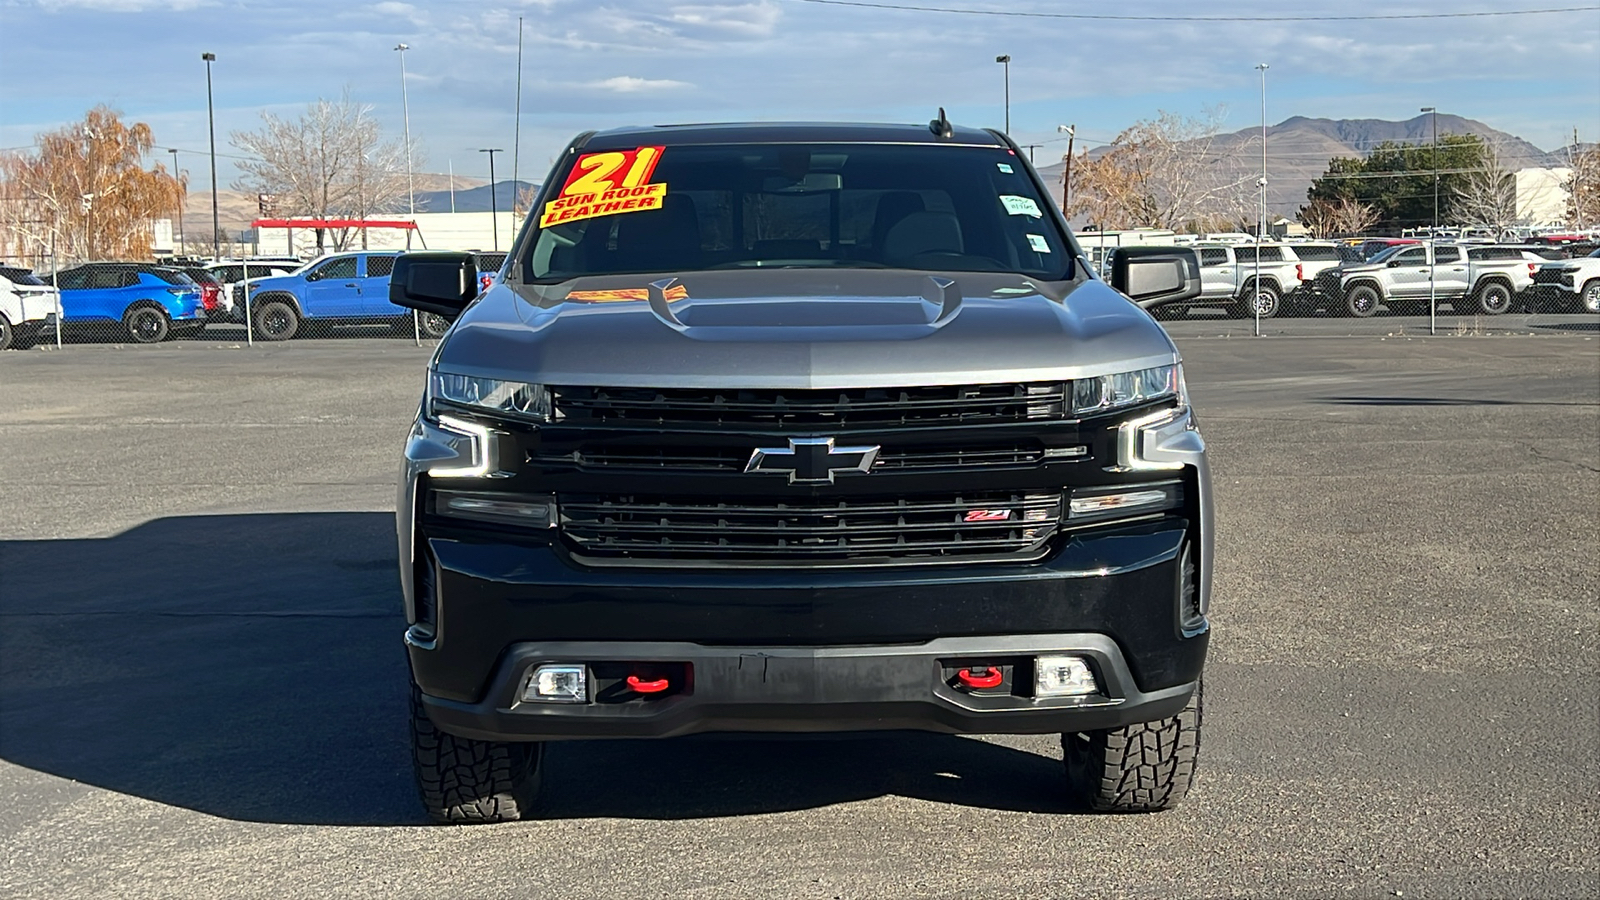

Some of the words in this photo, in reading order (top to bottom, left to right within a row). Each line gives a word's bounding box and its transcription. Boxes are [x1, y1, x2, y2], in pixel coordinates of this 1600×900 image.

[565, 147, 657, 195] 21
[545, 197, 656, 224] LEATHER
[552, 194, 596, 211] SUN
[601, 185, 660, 201] ROOF
